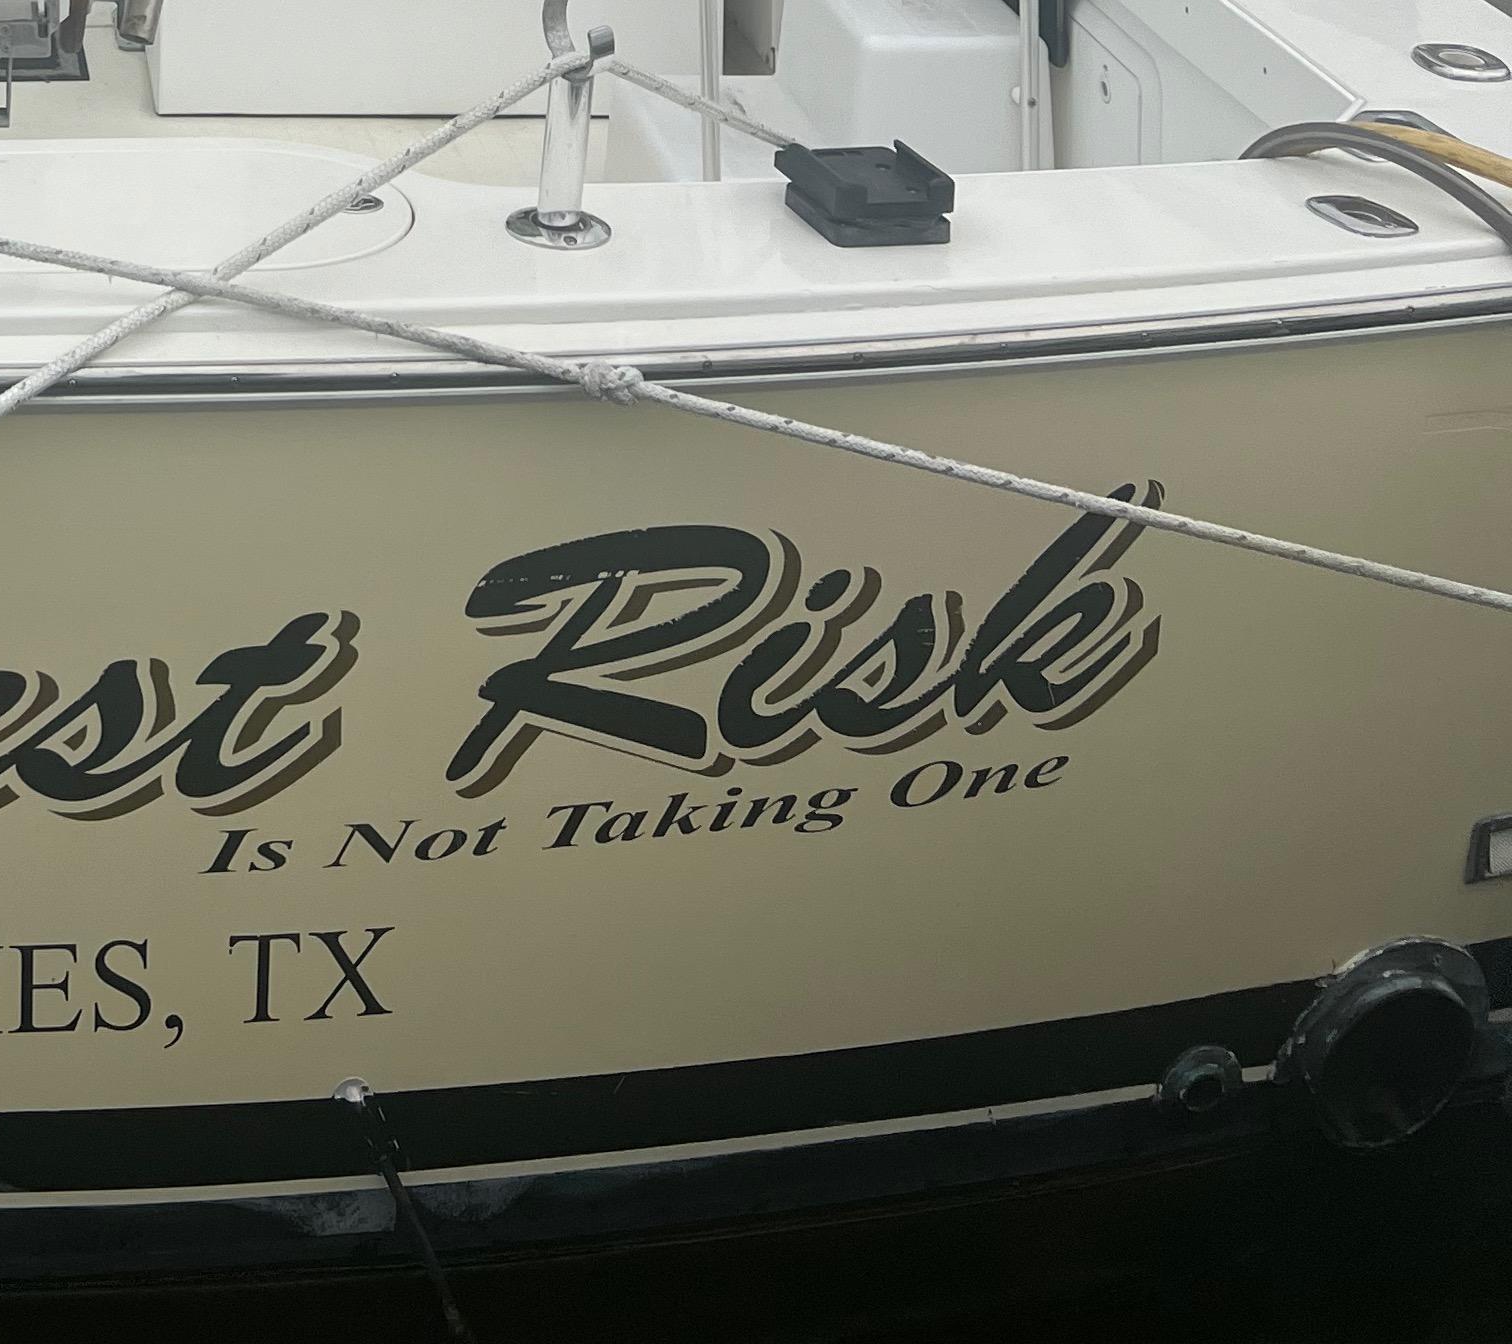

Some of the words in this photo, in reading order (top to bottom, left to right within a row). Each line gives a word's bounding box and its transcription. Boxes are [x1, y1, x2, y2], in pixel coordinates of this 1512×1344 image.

[445, 478, 1167, 800] Risk
[198, 827, 295, 875] Is
[321, 816, 510, 869] Not
[540, 784, 860, 853] Taking
[888, 753, 1071, 810] One
[228, 925, 397, 1026] TX
